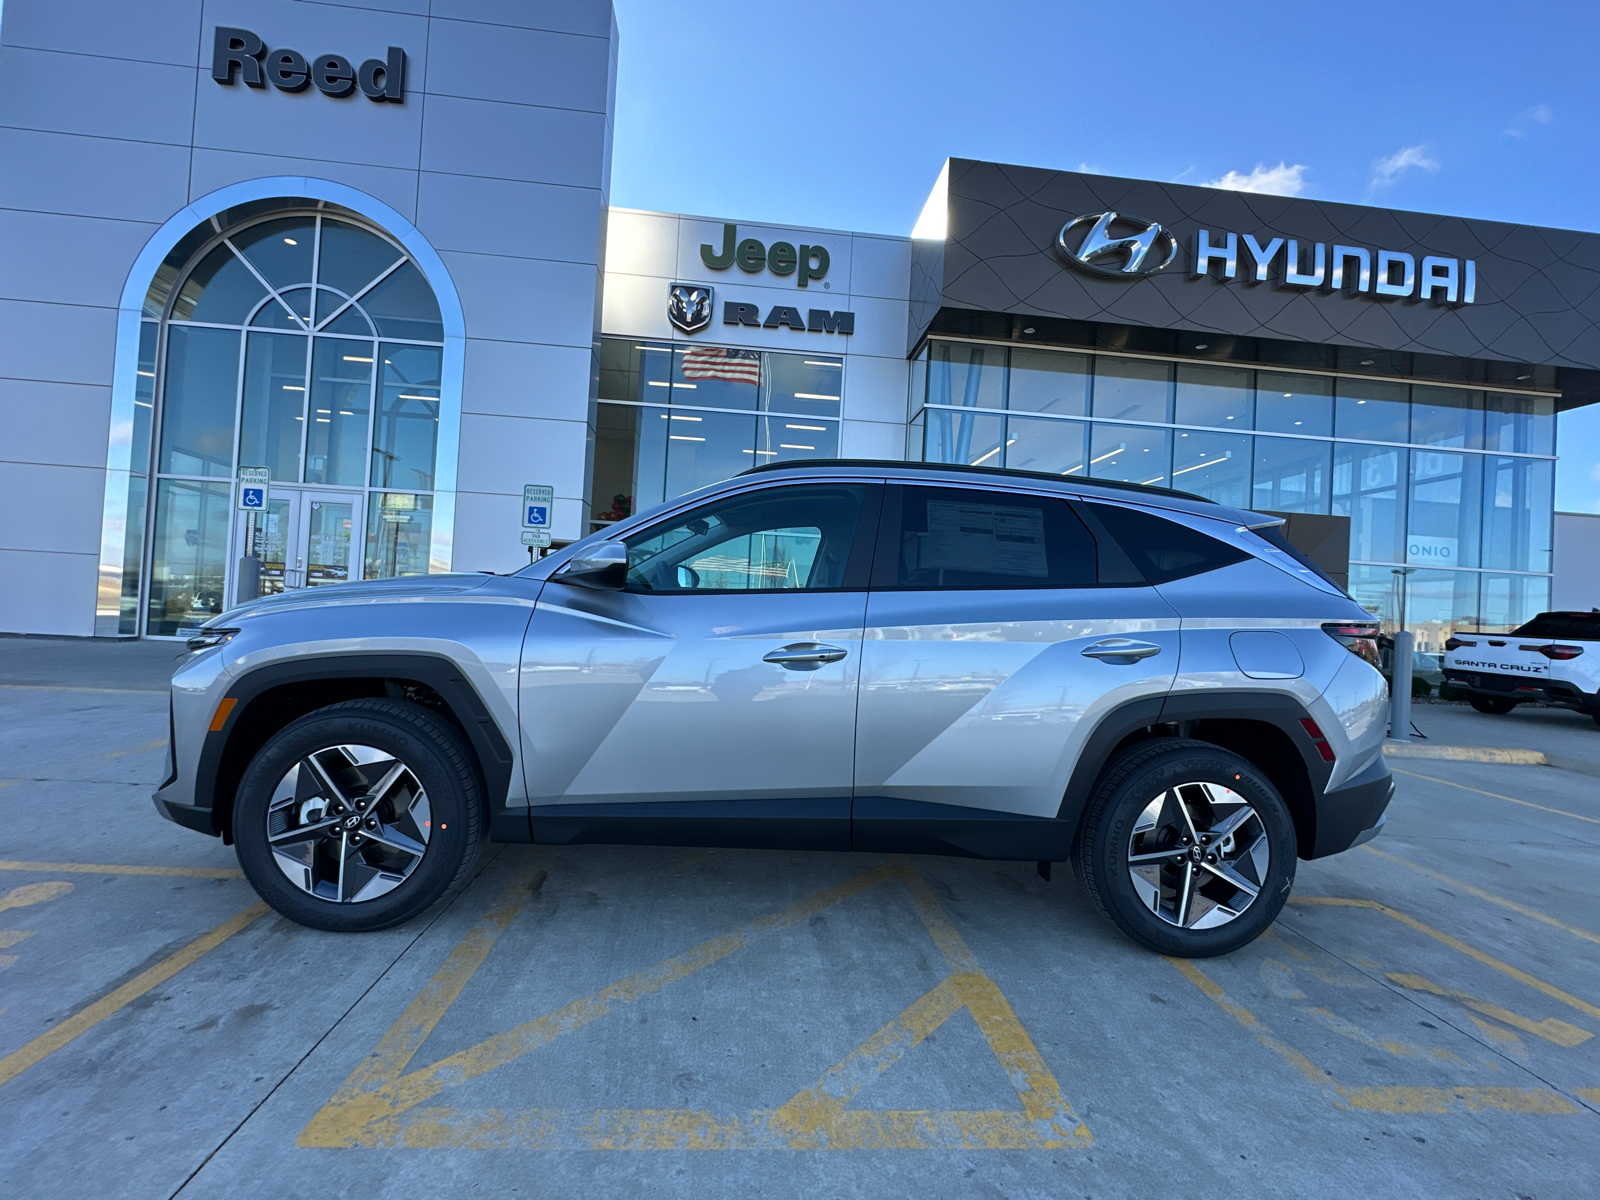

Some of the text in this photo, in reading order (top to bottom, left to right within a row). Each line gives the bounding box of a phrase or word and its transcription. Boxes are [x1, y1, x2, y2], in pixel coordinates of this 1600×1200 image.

[212, 26, 405, 103] Reed
[700, 223, 831, 287] Jeep
[1191, 229, 1477, 306] HYUNDAI
[723, 301, 855, 335] RAM
[241, 469, 267, 477] RESERVED
[241, 477, 267, 485] PARKING
[1455, 659, 1542, 673] SANTA CRUZ
[1109, 819, 1124, 876] KUMHO
